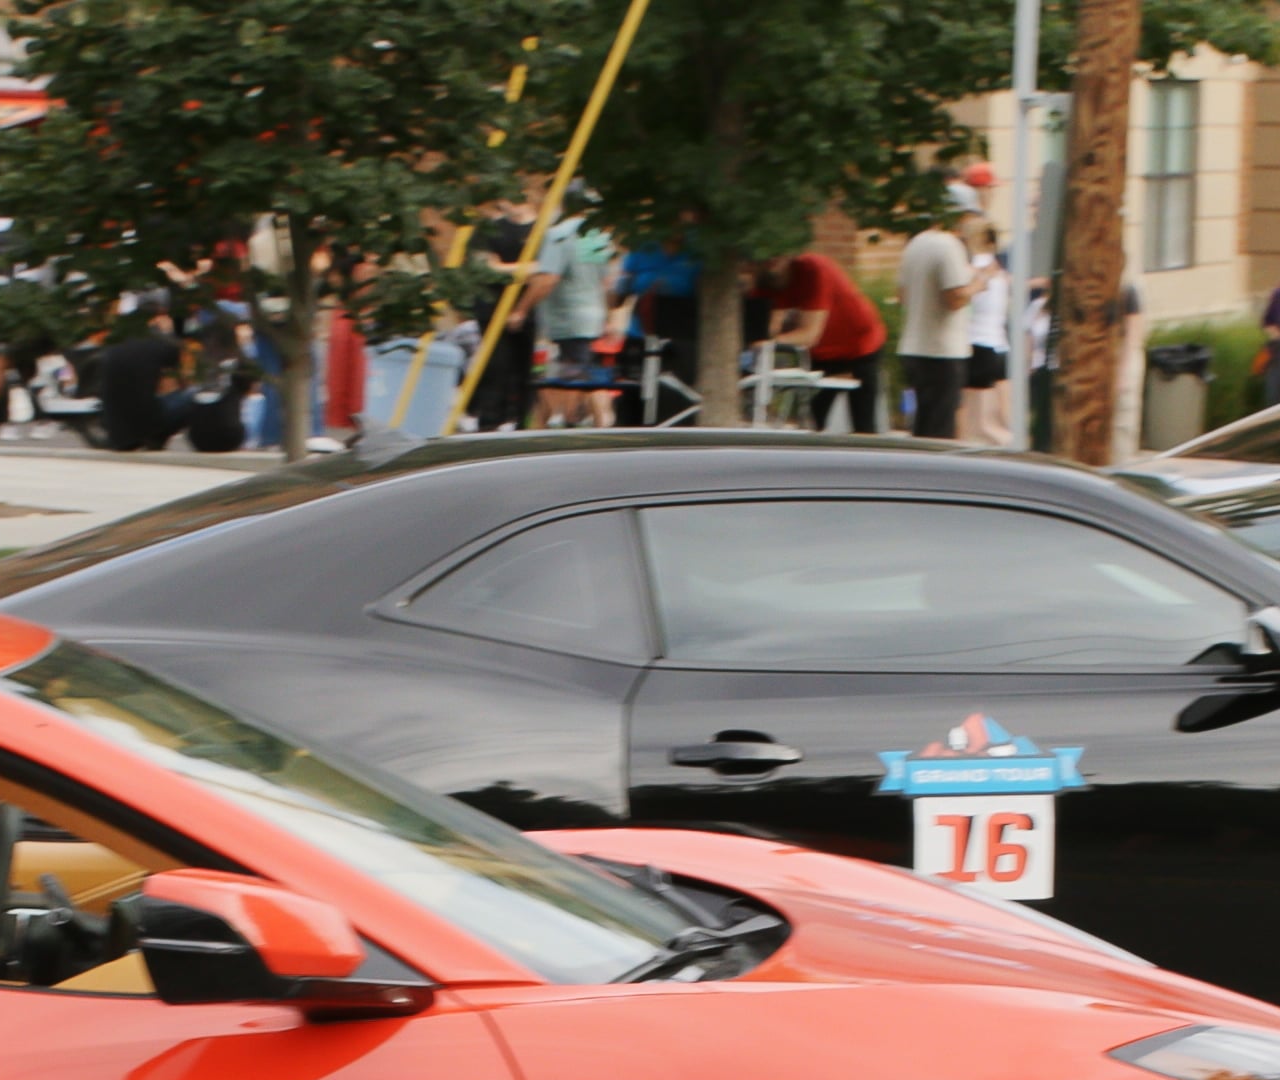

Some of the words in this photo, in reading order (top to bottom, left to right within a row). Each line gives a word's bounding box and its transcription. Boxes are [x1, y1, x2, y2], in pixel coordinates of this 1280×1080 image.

[911, 768, 990, 784] GRAND
[992, 766, 1052, 782] TOUR
[932, 812, 1033, 883] 16
